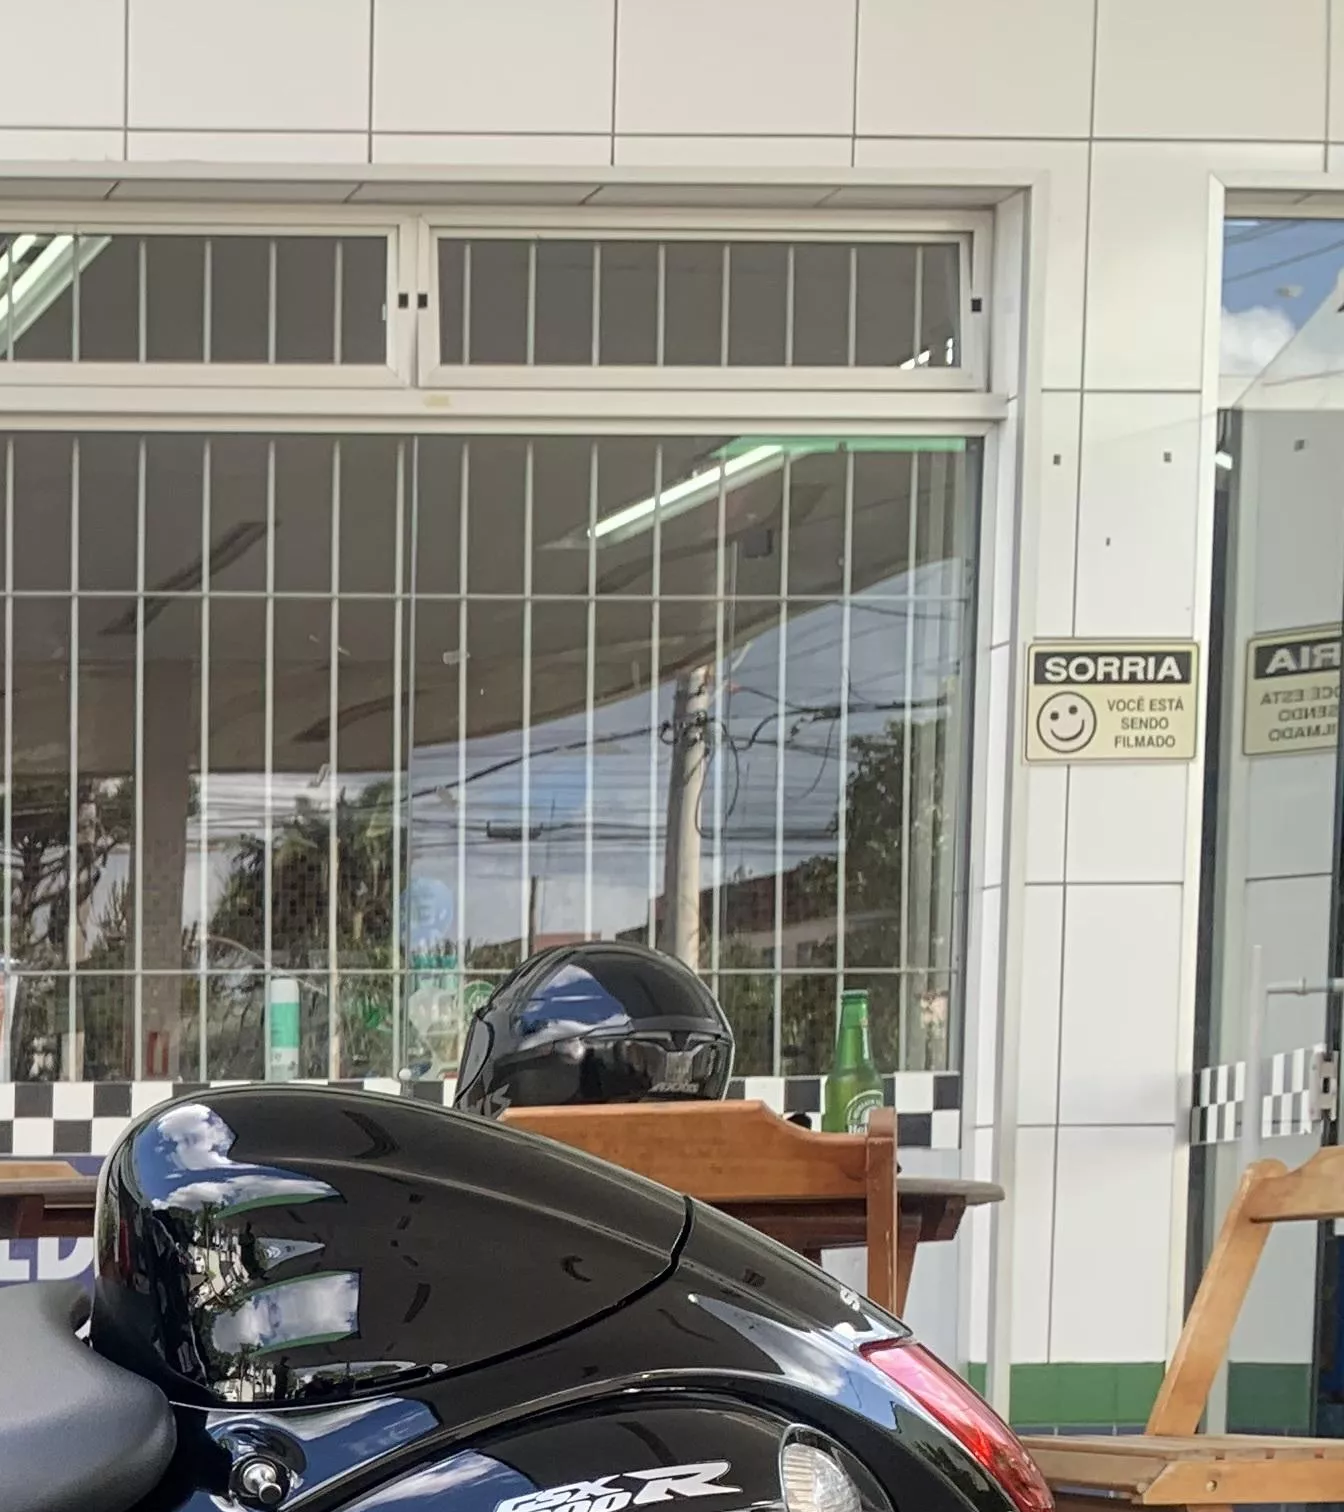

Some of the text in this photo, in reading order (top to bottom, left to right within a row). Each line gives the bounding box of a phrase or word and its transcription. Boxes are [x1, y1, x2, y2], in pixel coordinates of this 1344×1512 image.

[1044, 656, 1183, 682] SORRIA
[1107, 696, 1185, 712] VOCÊ ESTÁ
[1121, 716, 1169, 730] SENDO
[1114, 735, 1176, 749] FILMADO
